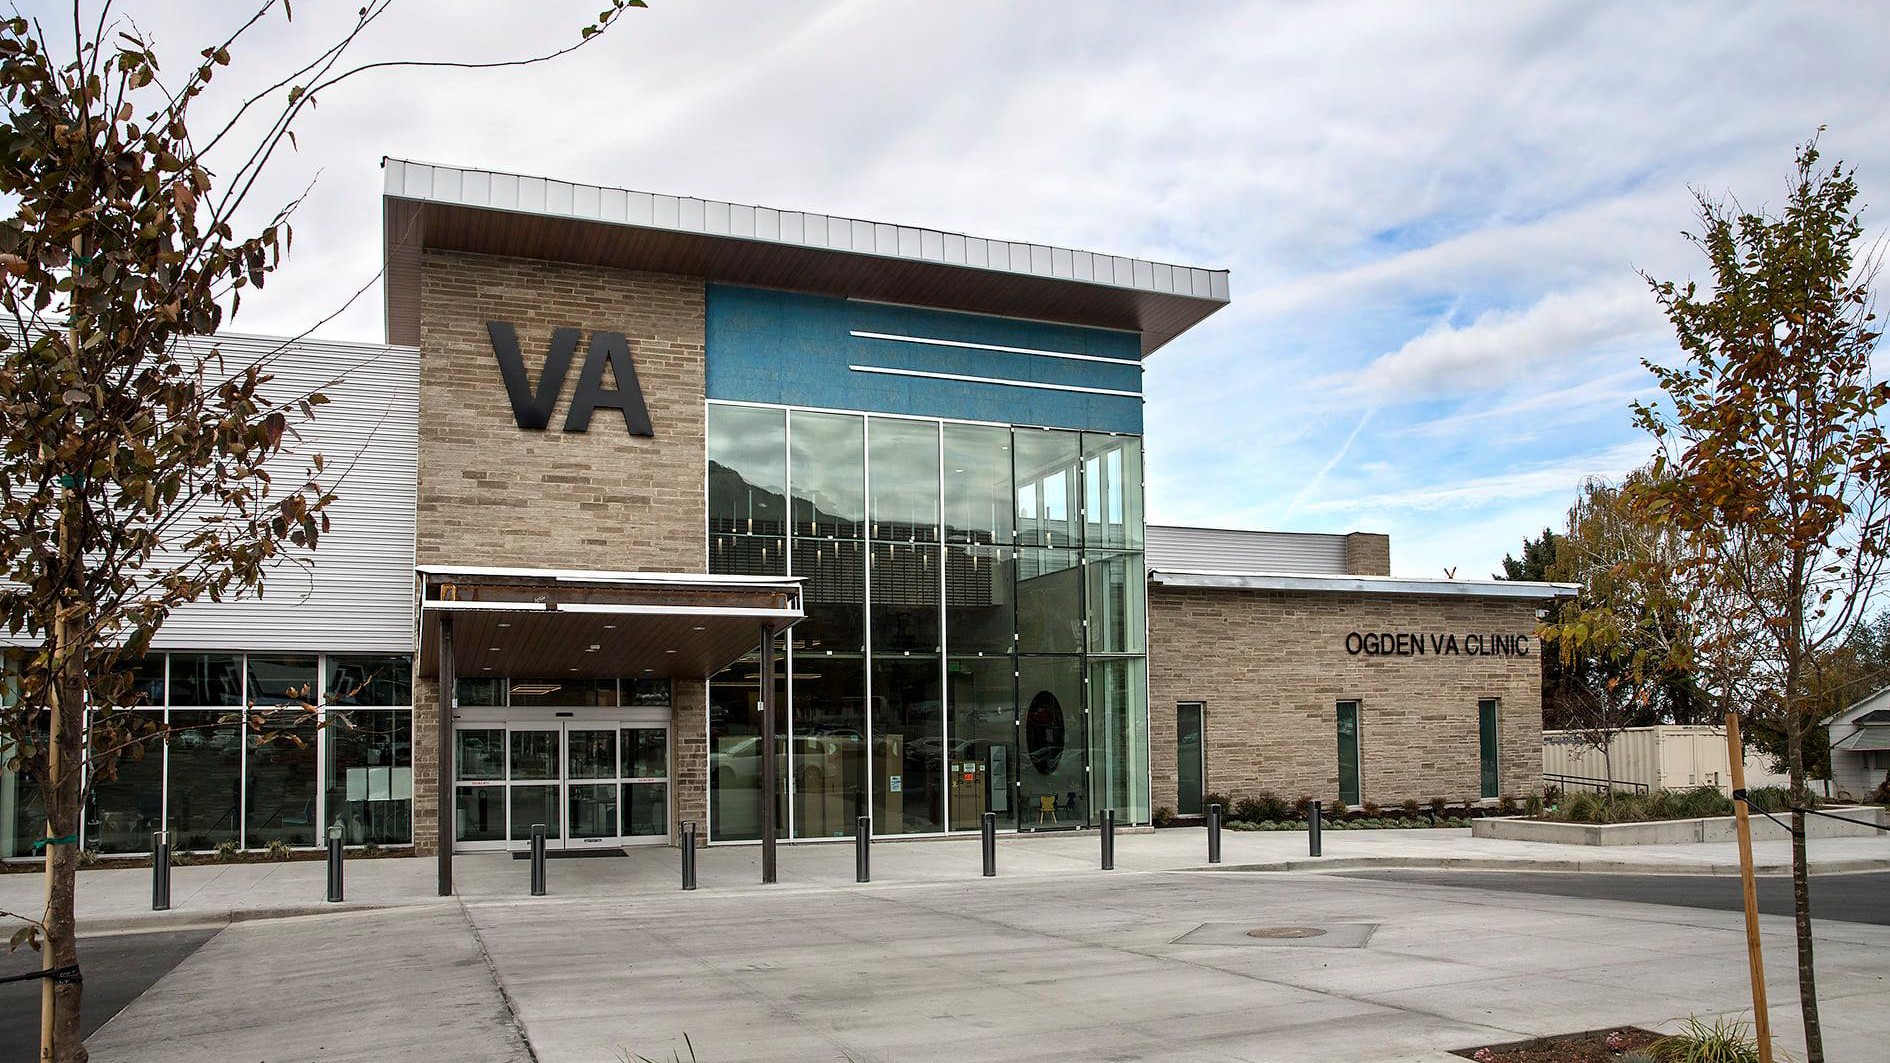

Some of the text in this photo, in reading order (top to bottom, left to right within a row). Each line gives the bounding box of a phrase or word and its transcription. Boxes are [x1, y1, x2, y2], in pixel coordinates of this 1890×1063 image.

[486, 321, 655, 437] VA
[1345, 631, 1530, 657] OGDEN VA CLINIC
